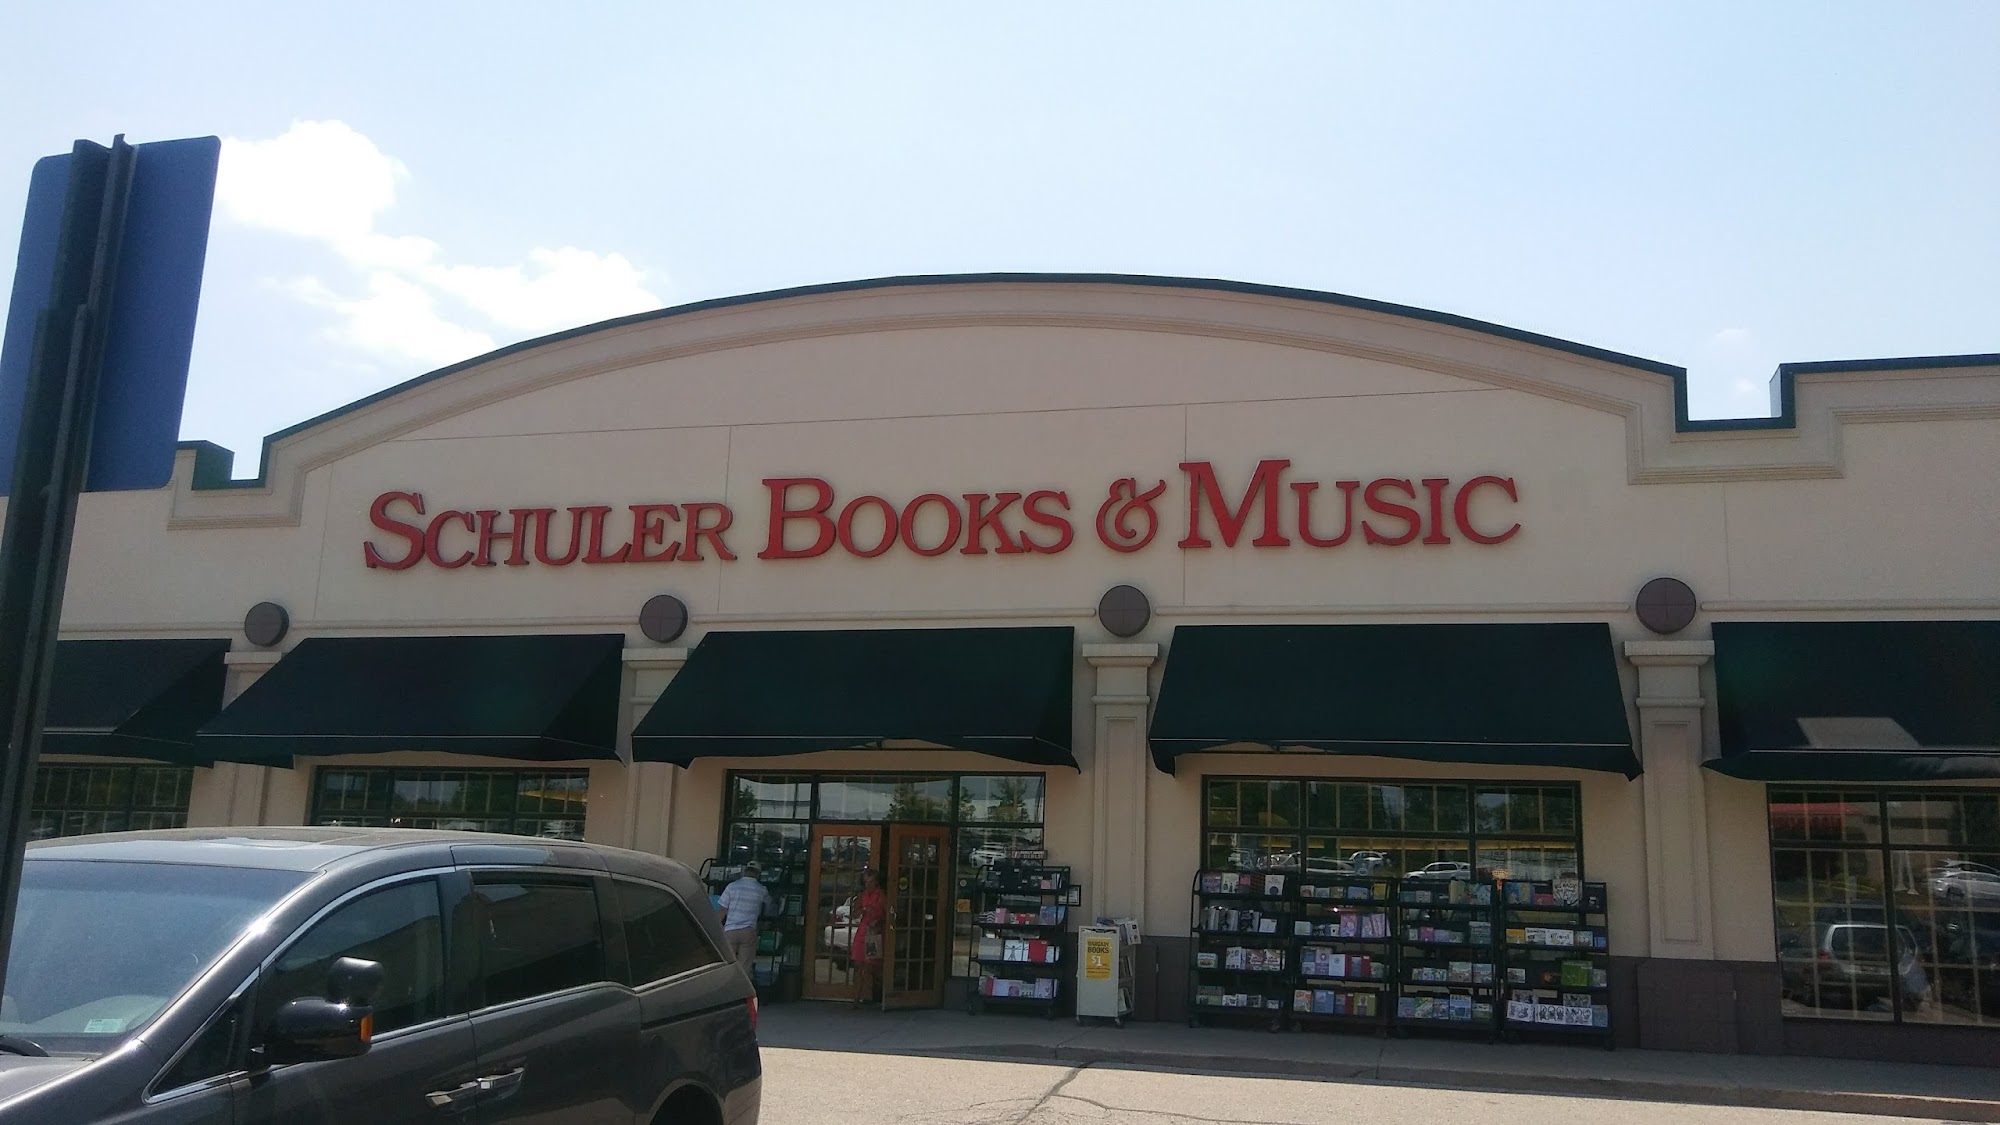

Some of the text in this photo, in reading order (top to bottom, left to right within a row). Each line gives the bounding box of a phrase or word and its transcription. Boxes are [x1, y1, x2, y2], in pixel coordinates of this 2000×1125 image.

[364, 459, 1521, 570] SCHULER BOOKS & MUSIC
[1091, 955, 1103, 967] $1
